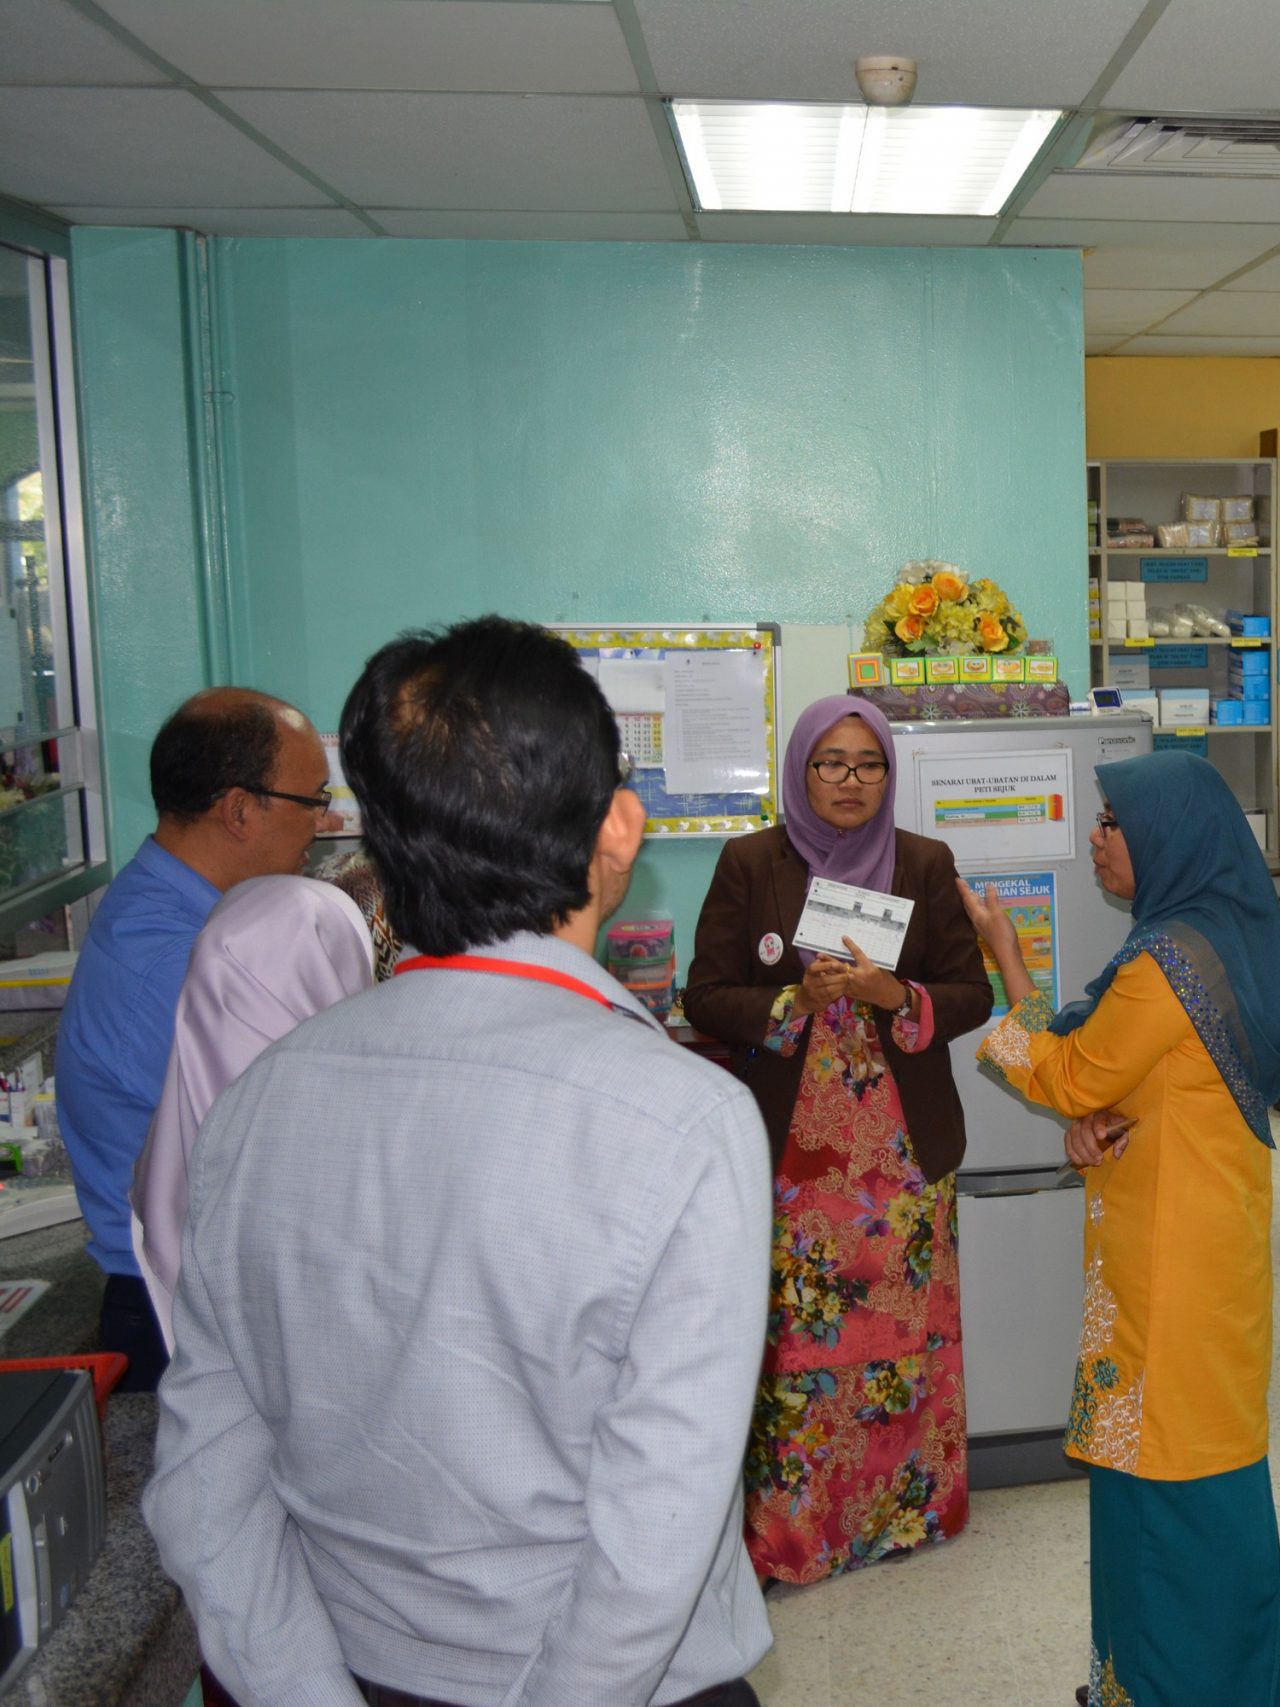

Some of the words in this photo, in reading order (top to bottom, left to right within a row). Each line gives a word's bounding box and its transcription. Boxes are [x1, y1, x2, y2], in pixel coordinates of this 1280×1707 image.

[1098, 736, 1136, 745] Panasonic
[932, 778, 964, 787] SENARAI
[965, 776, 1018, 786] UBAT-UBATAN
[1030, 774, 1057, 783] DALAM
[1019, 885, 1050, 896] SEJUK
